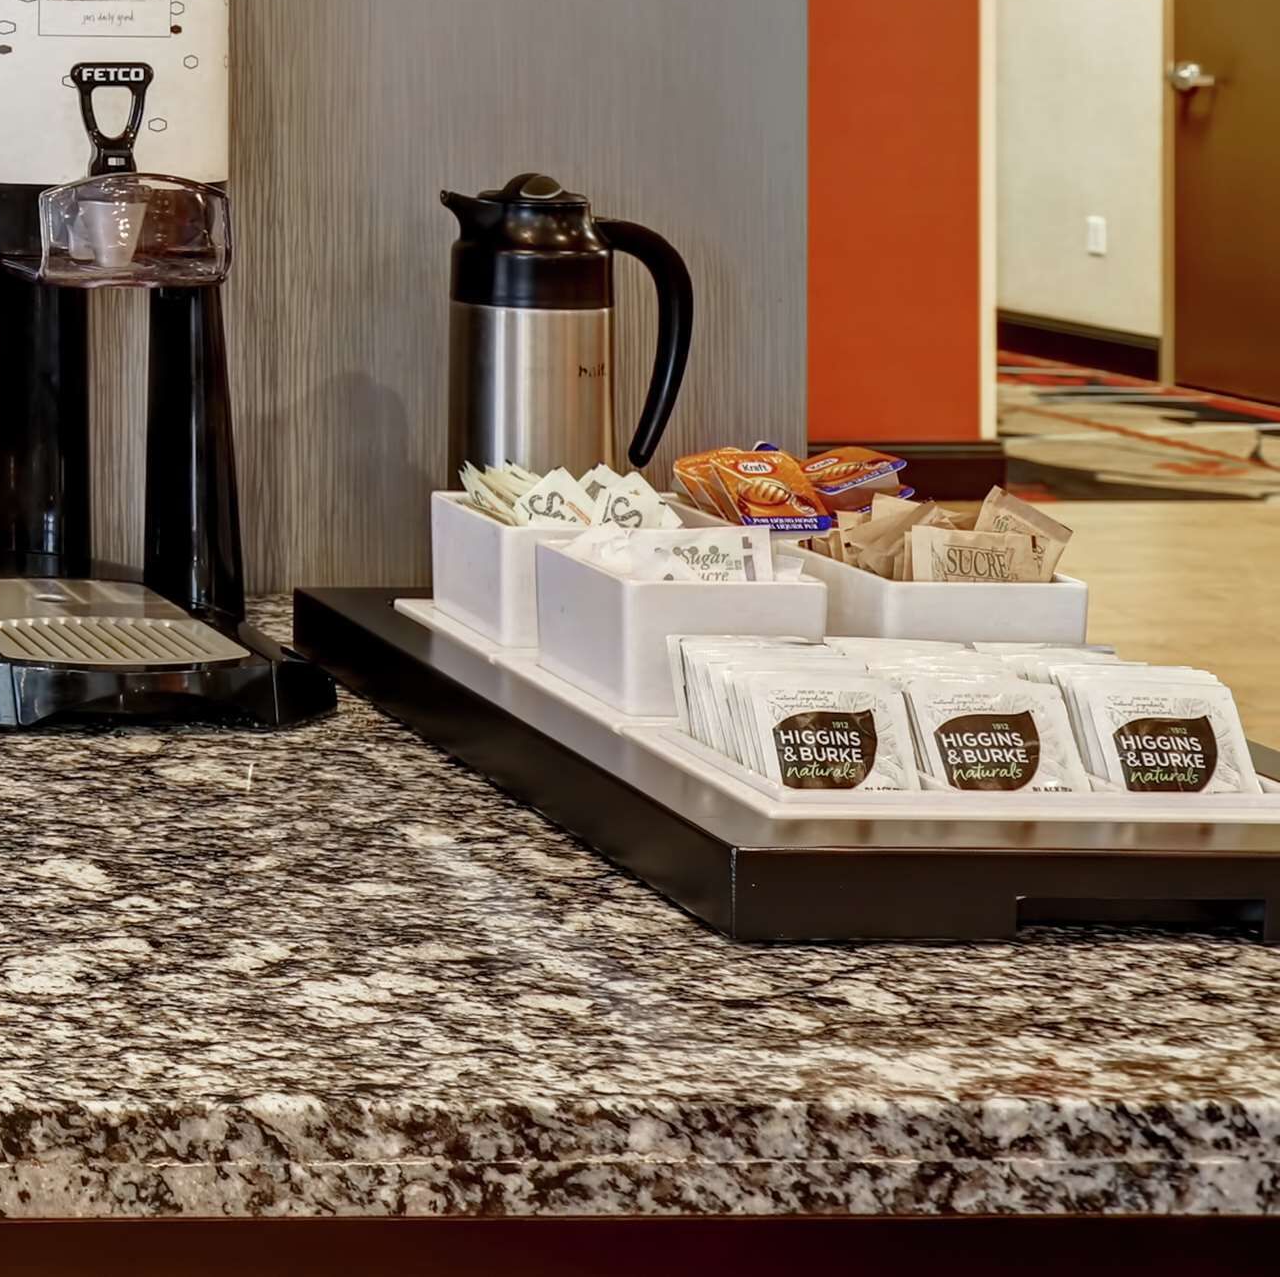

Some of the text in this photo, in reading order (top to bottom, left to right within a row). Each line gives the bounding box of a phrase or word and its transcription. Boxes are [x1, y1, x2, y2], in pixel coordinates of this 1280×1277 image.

[82, 68, 145, 82] FETCO
[742, 463, 769, 473] Kraft
[680, 547, 730, 571] Sugar
[946, 548, 1010, 579] SUCRE
[992, 723, 1009, 731] 1912
[780, 730, 861, 747] HIGGINS
[942, 732, 1024, 748] HIGGINS
[1121, 735, 1202, 752] HIGGINS
[800, 747, 864, 763] BURKE
[964, 749, 1029, 764] BURKE
[1144, 752, 1206, 769] BURKE
[787, 761, 856, 779] naturals
[953, 762, 1023, 781] naturals
[1131, 768, 1199, 785] naturals
